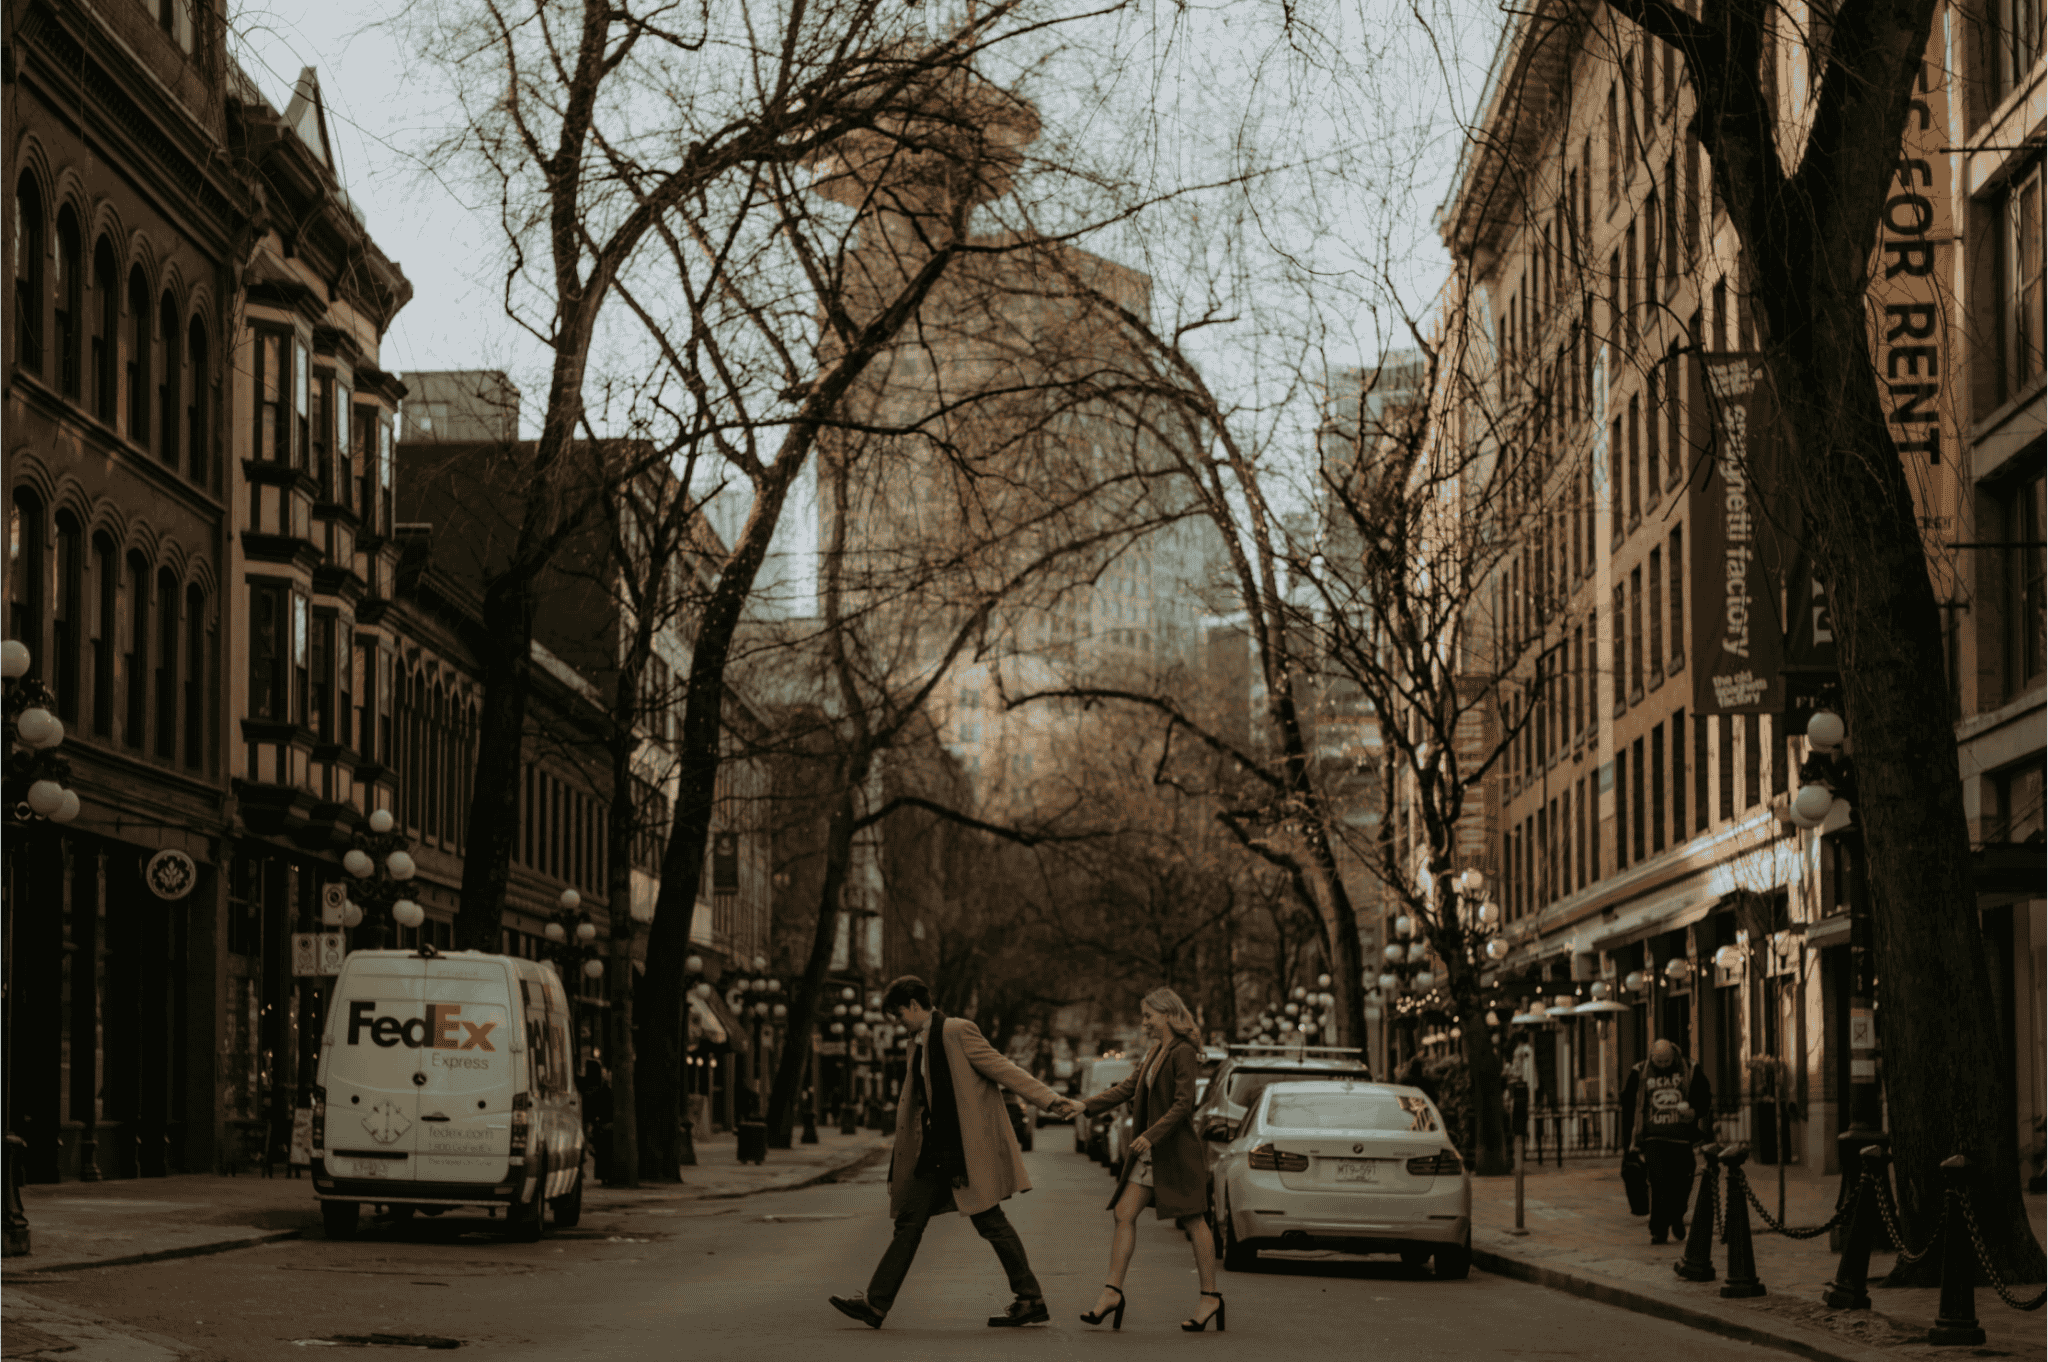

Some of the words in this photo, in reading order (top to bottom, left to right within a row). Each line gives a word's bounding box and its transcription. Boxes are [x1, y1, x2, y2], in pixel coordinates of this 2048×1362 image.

[1884, 158, 1935, 281] FOR
[1886, 304, 1941, 466] RENT
[1722, 546, 1753, 659] factory
[347, 1001, 497, 1052] FedEx
[431, 1052, 489, 1070] Express
